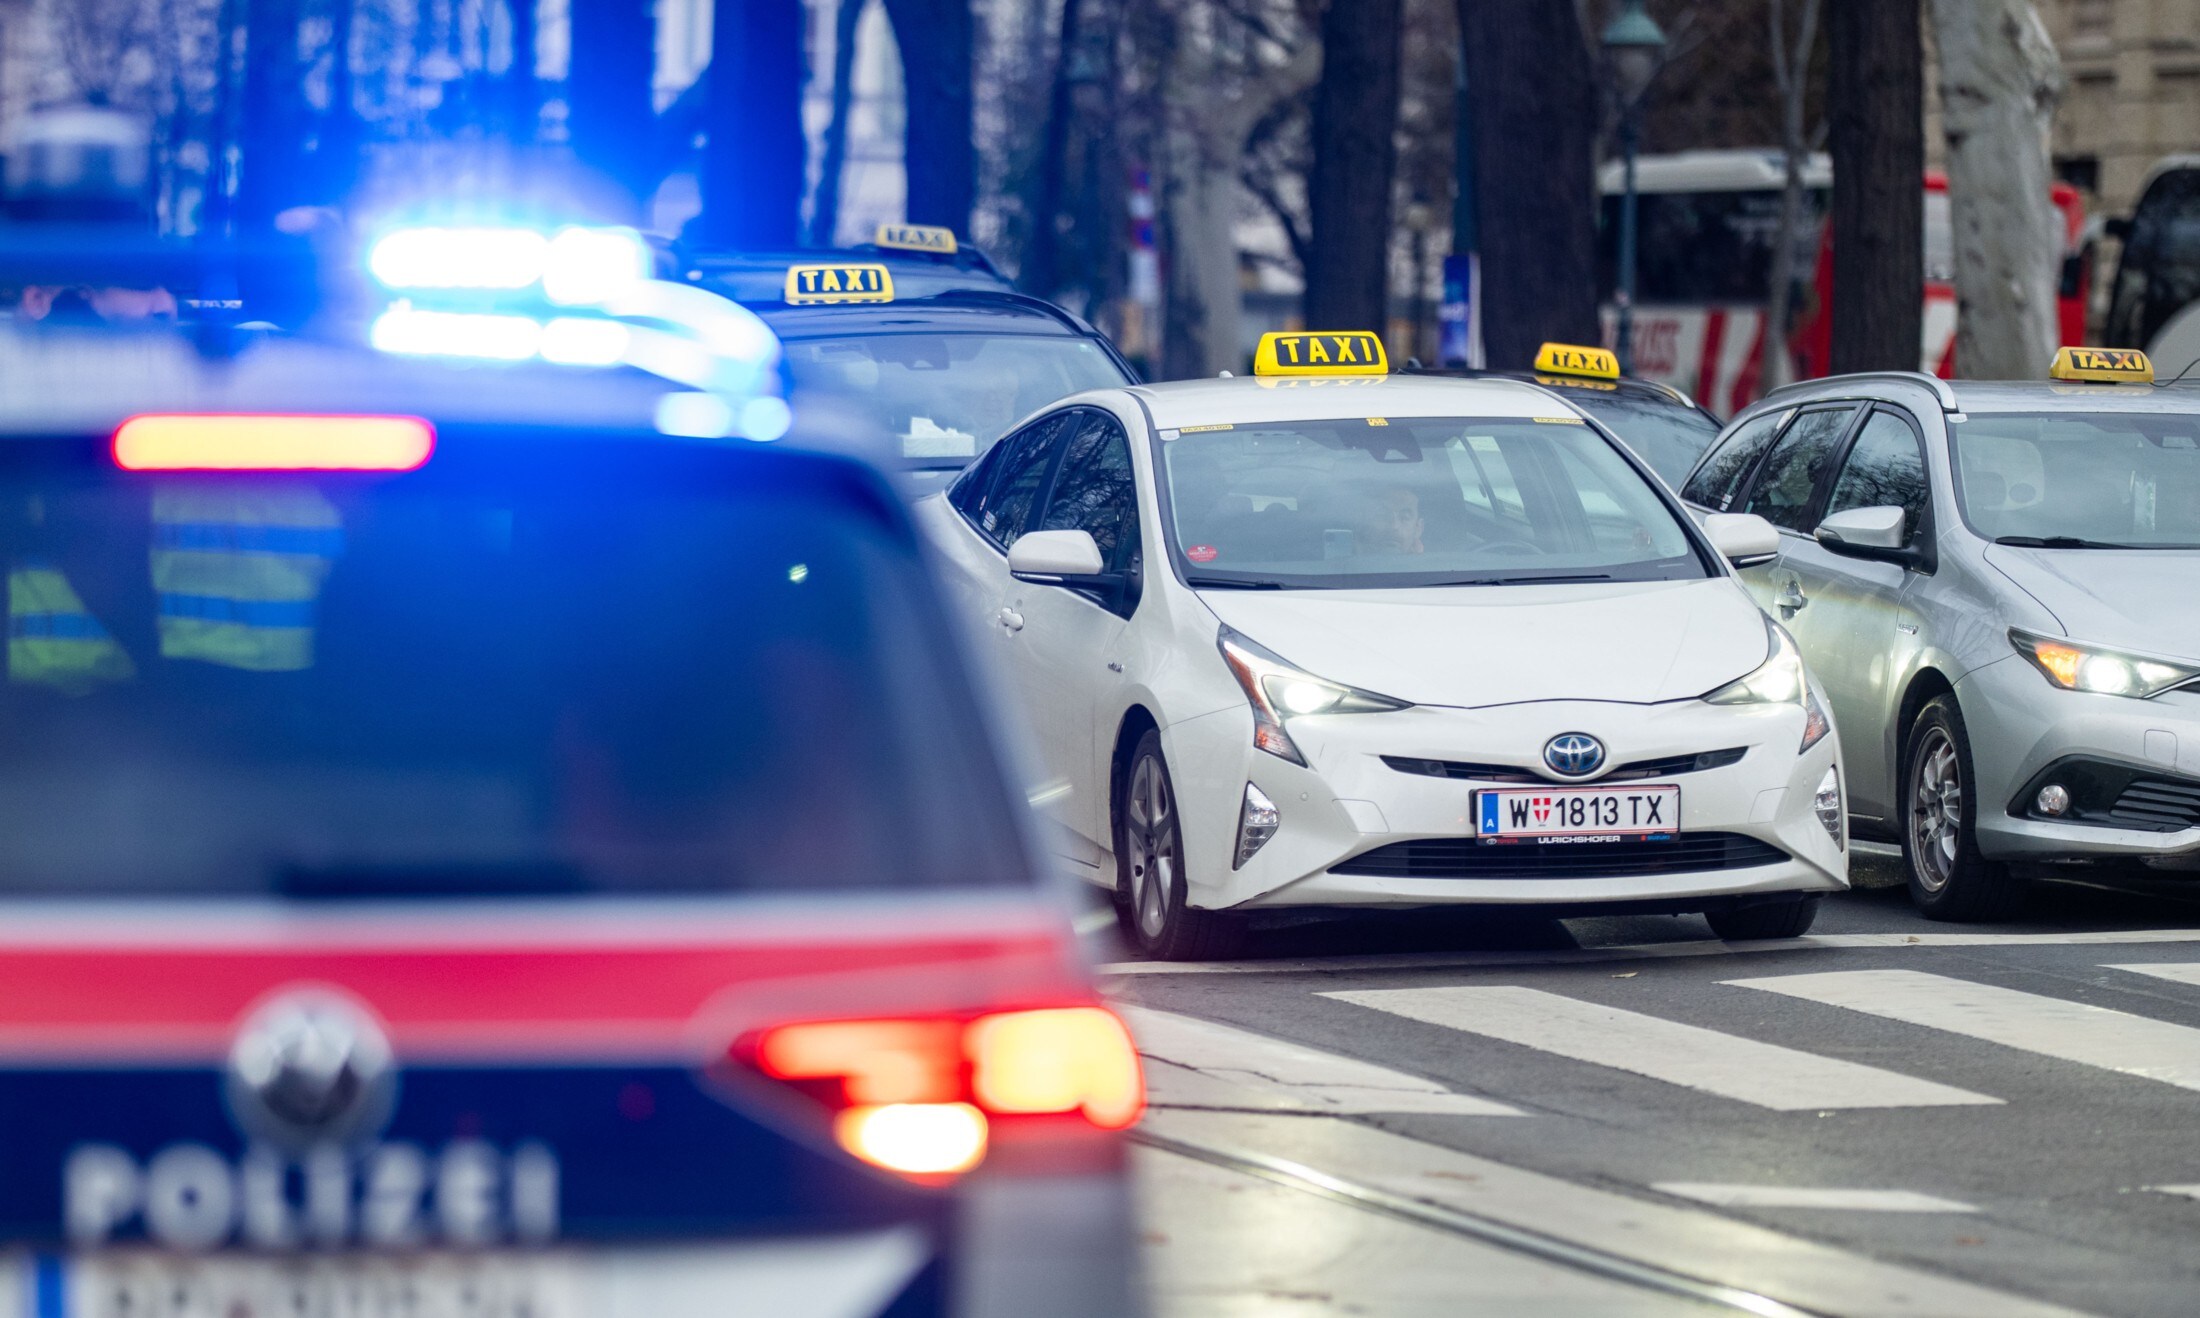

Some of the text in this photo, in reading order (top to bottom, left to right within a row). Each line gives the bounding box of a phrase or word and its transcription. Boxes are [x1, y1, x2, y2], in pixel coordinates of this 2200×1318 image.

[801, 270, 879, 292] TAXI
[1281, 337, 1373, 363] TAXI
[2072, 351, 2143, 370] TAXI
[1554, 351, 1608, 371] TAXI
[1509, 794, 1663, 828] W 1813 TX
[1485, 818, 1495, 828] A
[1538, 835, 1621, 844] ULRICHSHOFER
[63, 1142, 561, 1248] POLIZEI
